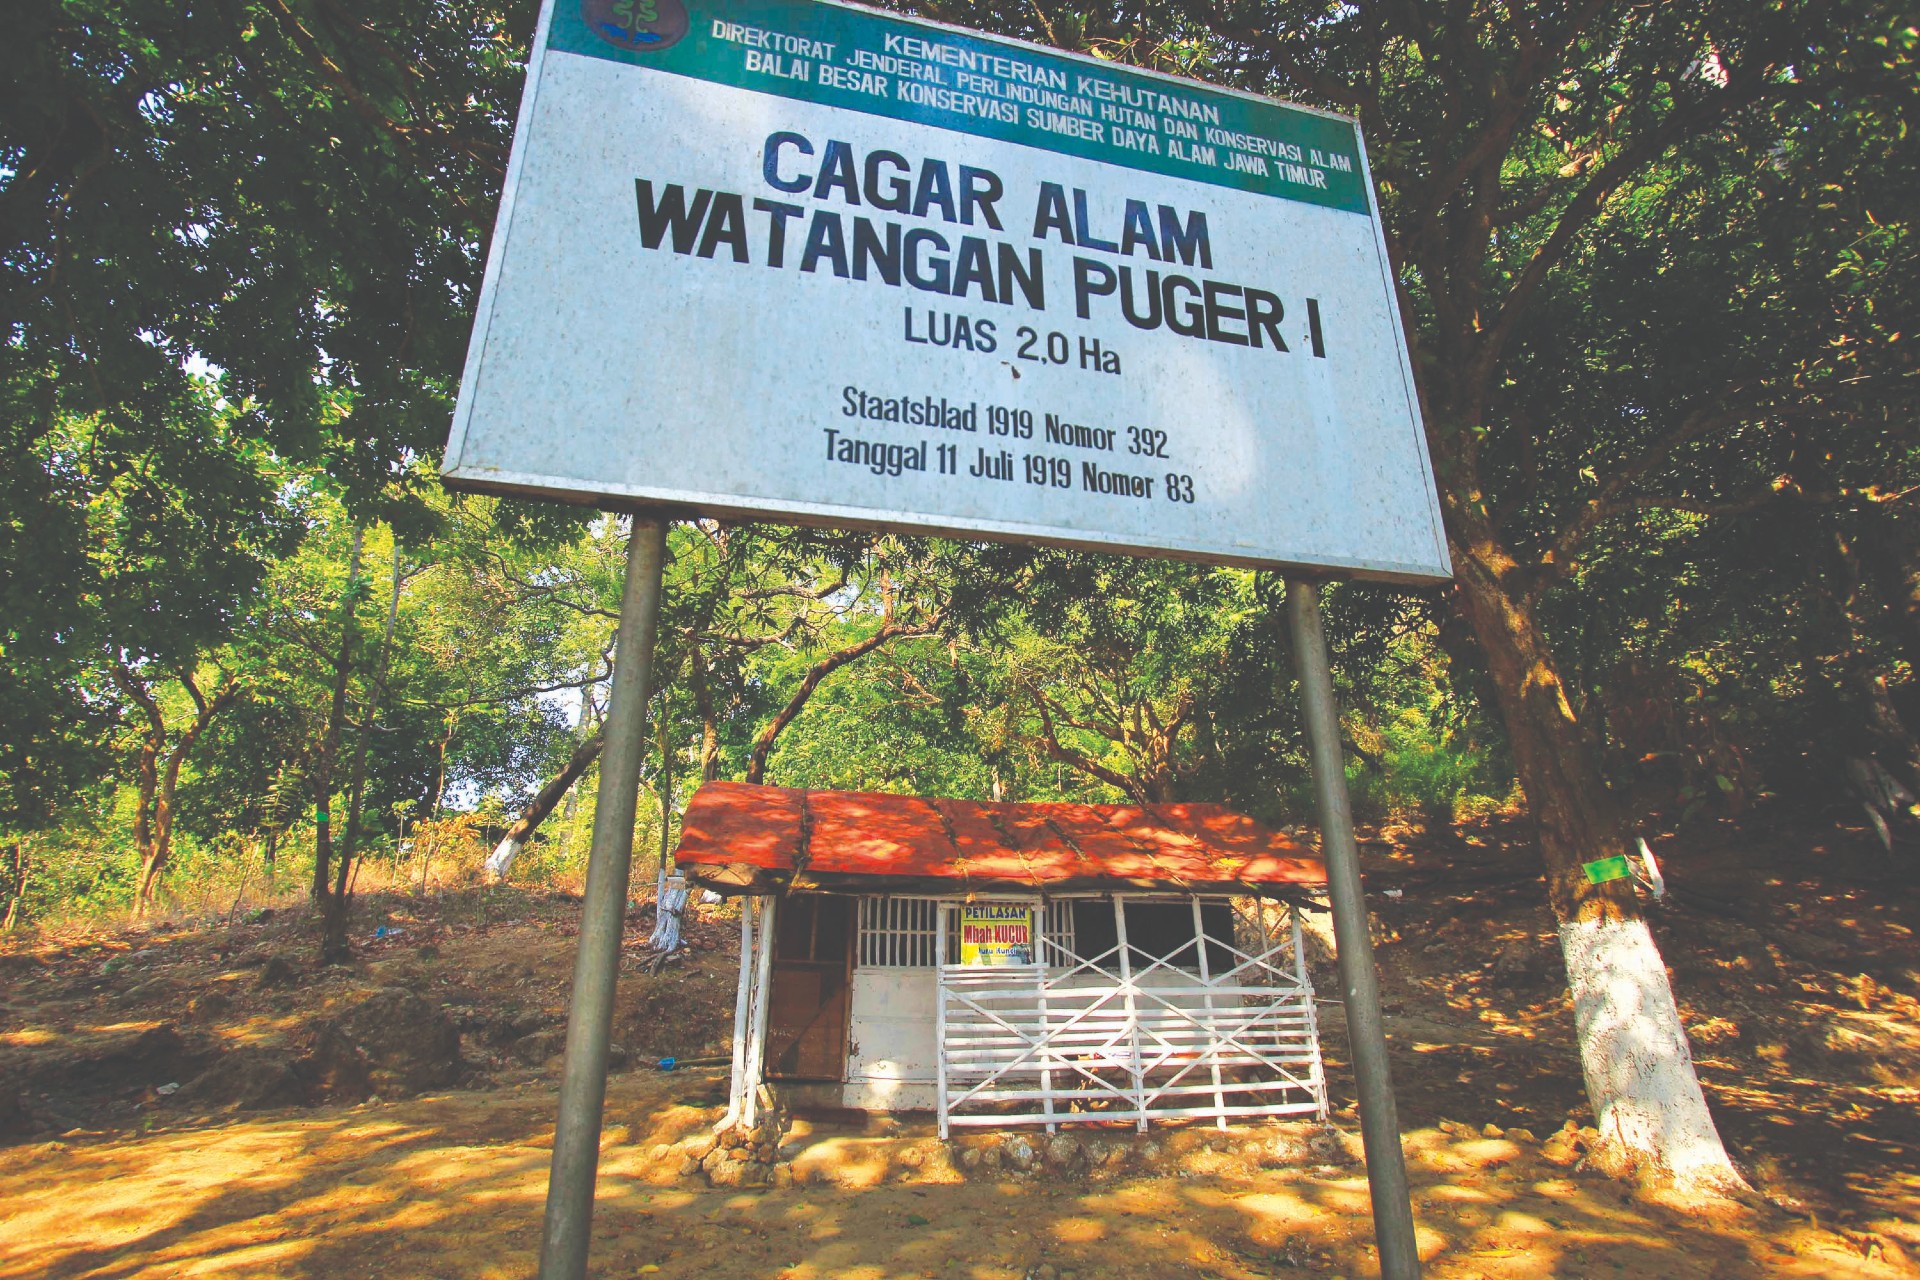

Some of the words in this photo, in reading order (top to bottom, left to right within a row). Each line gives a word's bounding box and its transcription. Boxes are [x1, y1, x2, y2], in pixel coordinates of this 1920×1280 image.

[711, 19, 836, 62] DIREKTORAT
[846, 48, 948, 86] JENDERAL
[956, 72, 1093, 118] PERLINDUNGAN
[1101, 102, 1158, 131] HUTAN
[1163, 116, 1199, 141] DAN
[1205, 127, 1303, 162] KONSERVASI
[1309, 148, 1353, 173] ALAM
[744, 50, 810, 83] BALAI
[818, 63, 888, 99] BESAR
[897, 79, 1020, 126] KONSERVASI
[1026, 107, 1105, 144] SUMBER
[1111, 127, 1161, 156] DAYA
[1167, 139, 1217, 168] ALAM
[1223, 150, 1270, 178] JAWA
[1273, 159, 1328, 191] TIMUR
[883, 32, 1068, 92] KEMENTERIAN
[1077, 76, 1220, 126] KEHUTANAN
[762, 130, 1005, 233] CAGAR
[1032, 180, 1214, 270] ALAM
[634, 177, 1046, 312] WATANGAN
[1072, 255, 1290, 354] PUGER
[1304, 296, 1327, 359] I
[903, 306, 998, 354] LUAS
[1016, 325, 1070, 367] 2,0
[1079, 337, 1122, 376] Ha
[841, 385, 977, 434] Staatsblad
[985, 406, 1034, 441] 1919
[1045, 416, 1117, 453] Nomor
[1125, 425, 1169, 460] 392
[823, 428, 927, 477] Tanggal
[935, 444, 958, 475] 11
[968, 445, 1015, 483] Juli
[1021, 454, 1072, 489] 1919
[1081, 461, 1155, 499] Nomor
[1165, 472, 1196, 505] 83
[963, 924, 992, 944] Mbah
[965, 906, 1026, 919] PETILASAN
